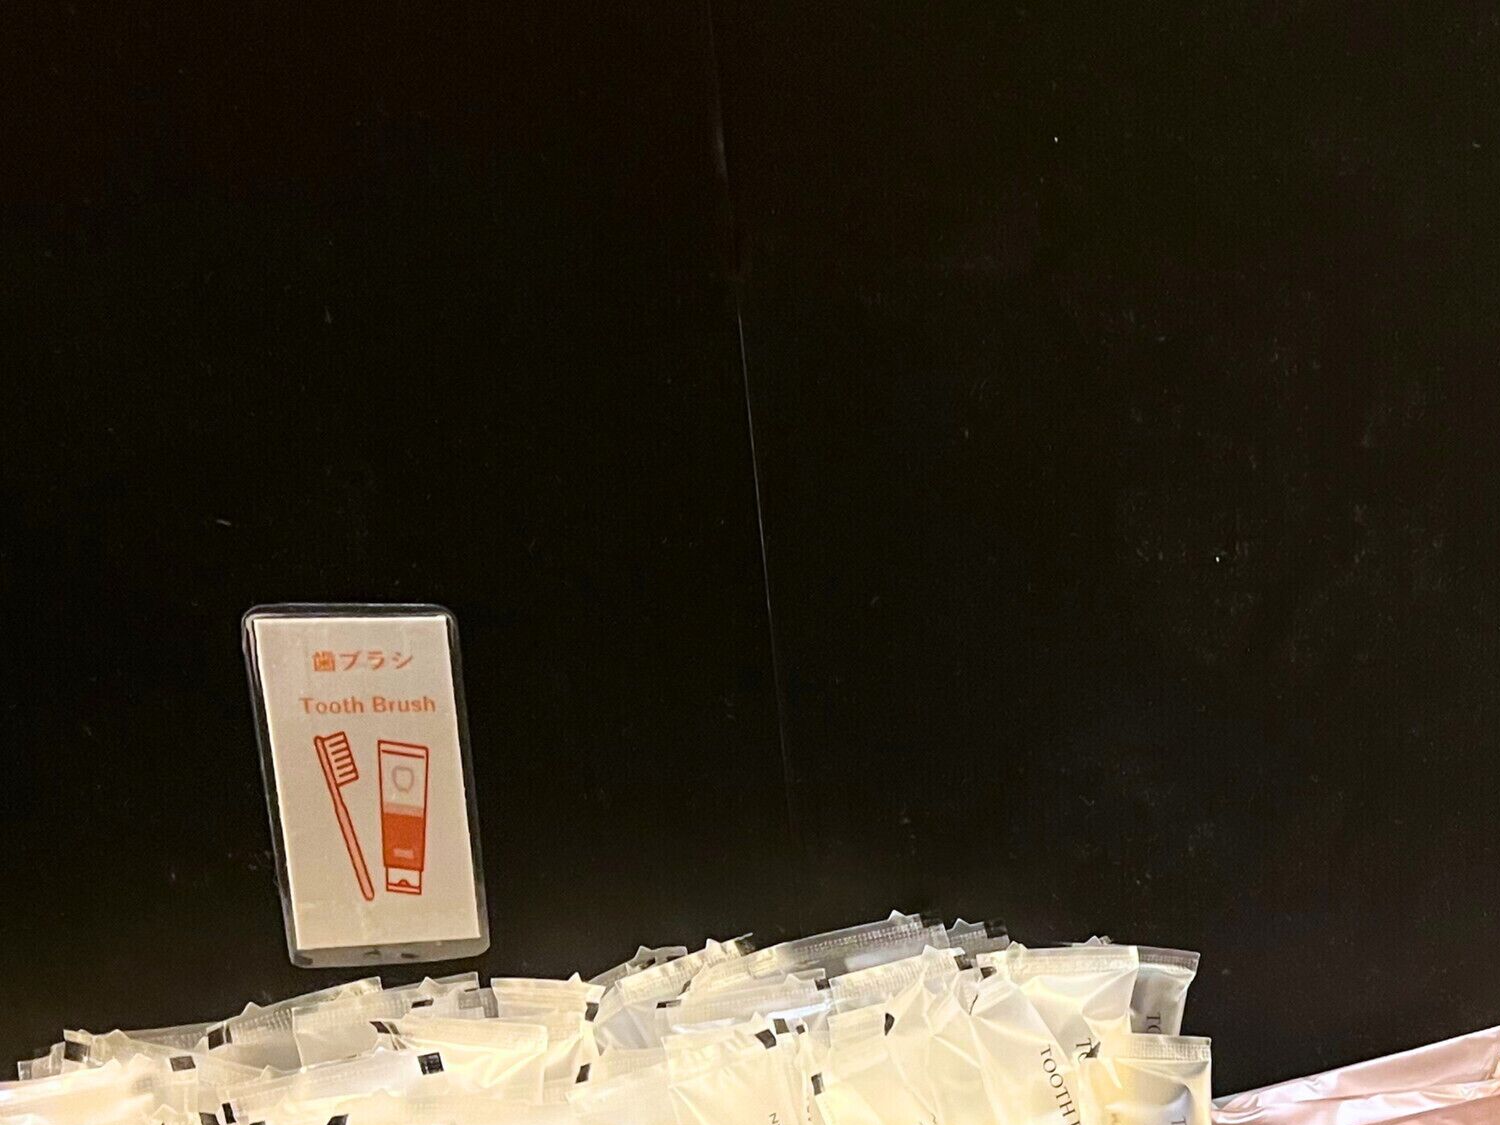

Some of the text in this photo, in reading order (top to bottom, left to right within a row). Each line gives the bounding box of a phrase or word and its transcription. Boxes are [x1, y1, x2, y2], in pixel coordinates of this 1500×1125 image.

[312, 651, 413, 672] 歯ブラシ
[299, 696, 436, 715] Tooth Brush
[1040, 1046, 1076, 1117] TOOTH
